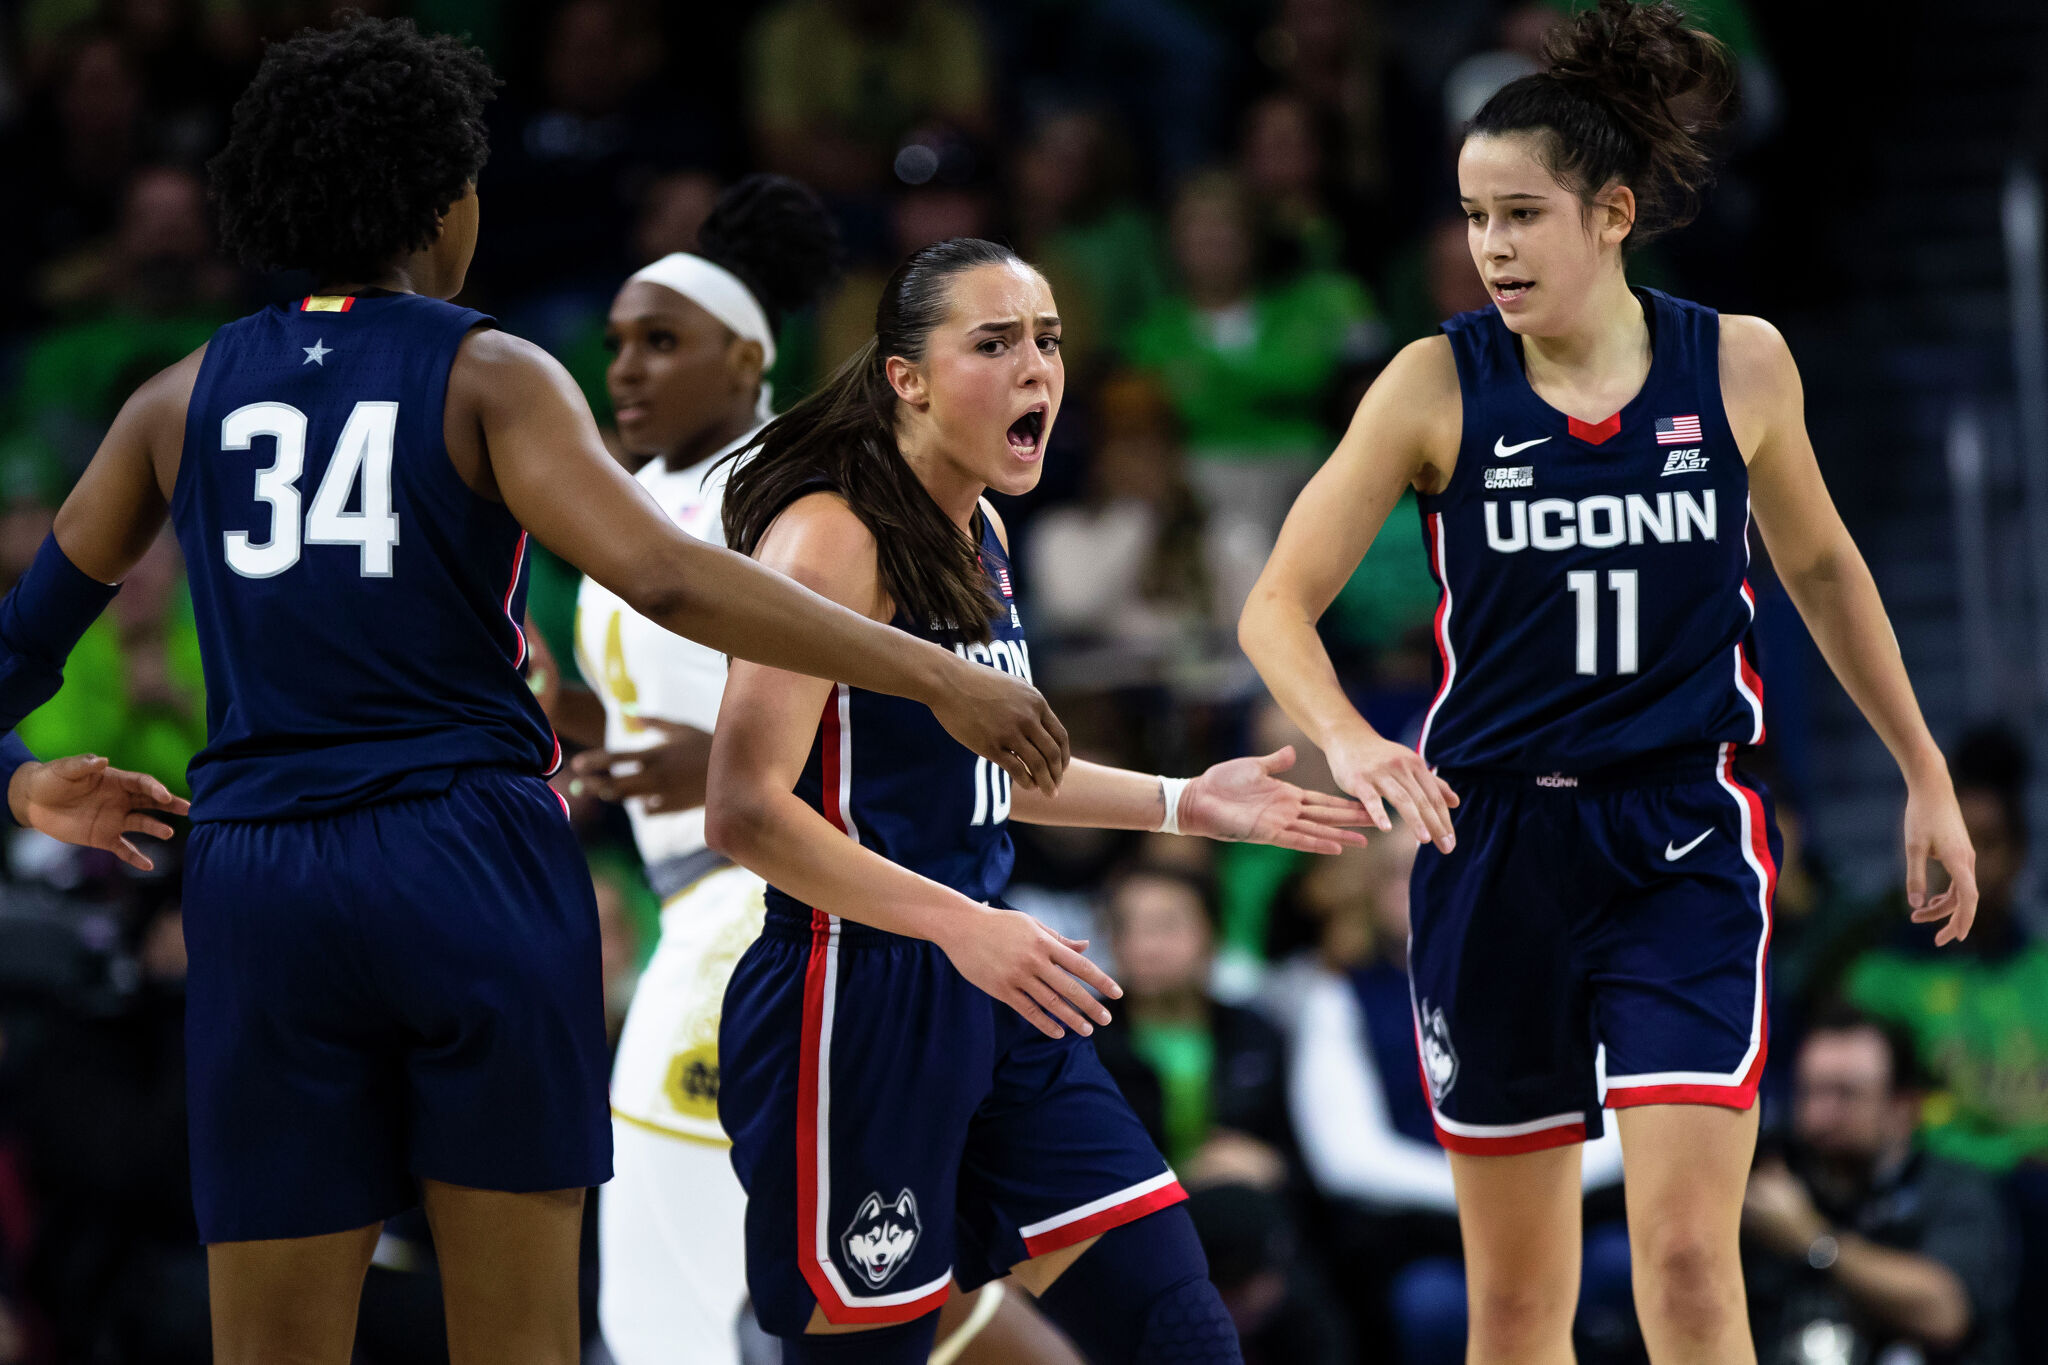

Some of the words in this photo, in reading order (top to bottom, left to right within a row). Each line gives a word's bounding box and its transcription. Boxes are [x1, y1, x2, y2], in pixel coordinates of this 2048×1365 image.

[1664, 457, 1710, 471] EAST
[1667, 448, 1700, 461] BIG
[221, 401, 400, 579] 34
[1484, 478, 1534, 489] CHANGE
[1484, 489, 1718, 553] UCONN
[1567, 569, 1639, 676] 11
[970, 755, 1011, 826] 10
[1536, 776, 1578, 788] UCONN
